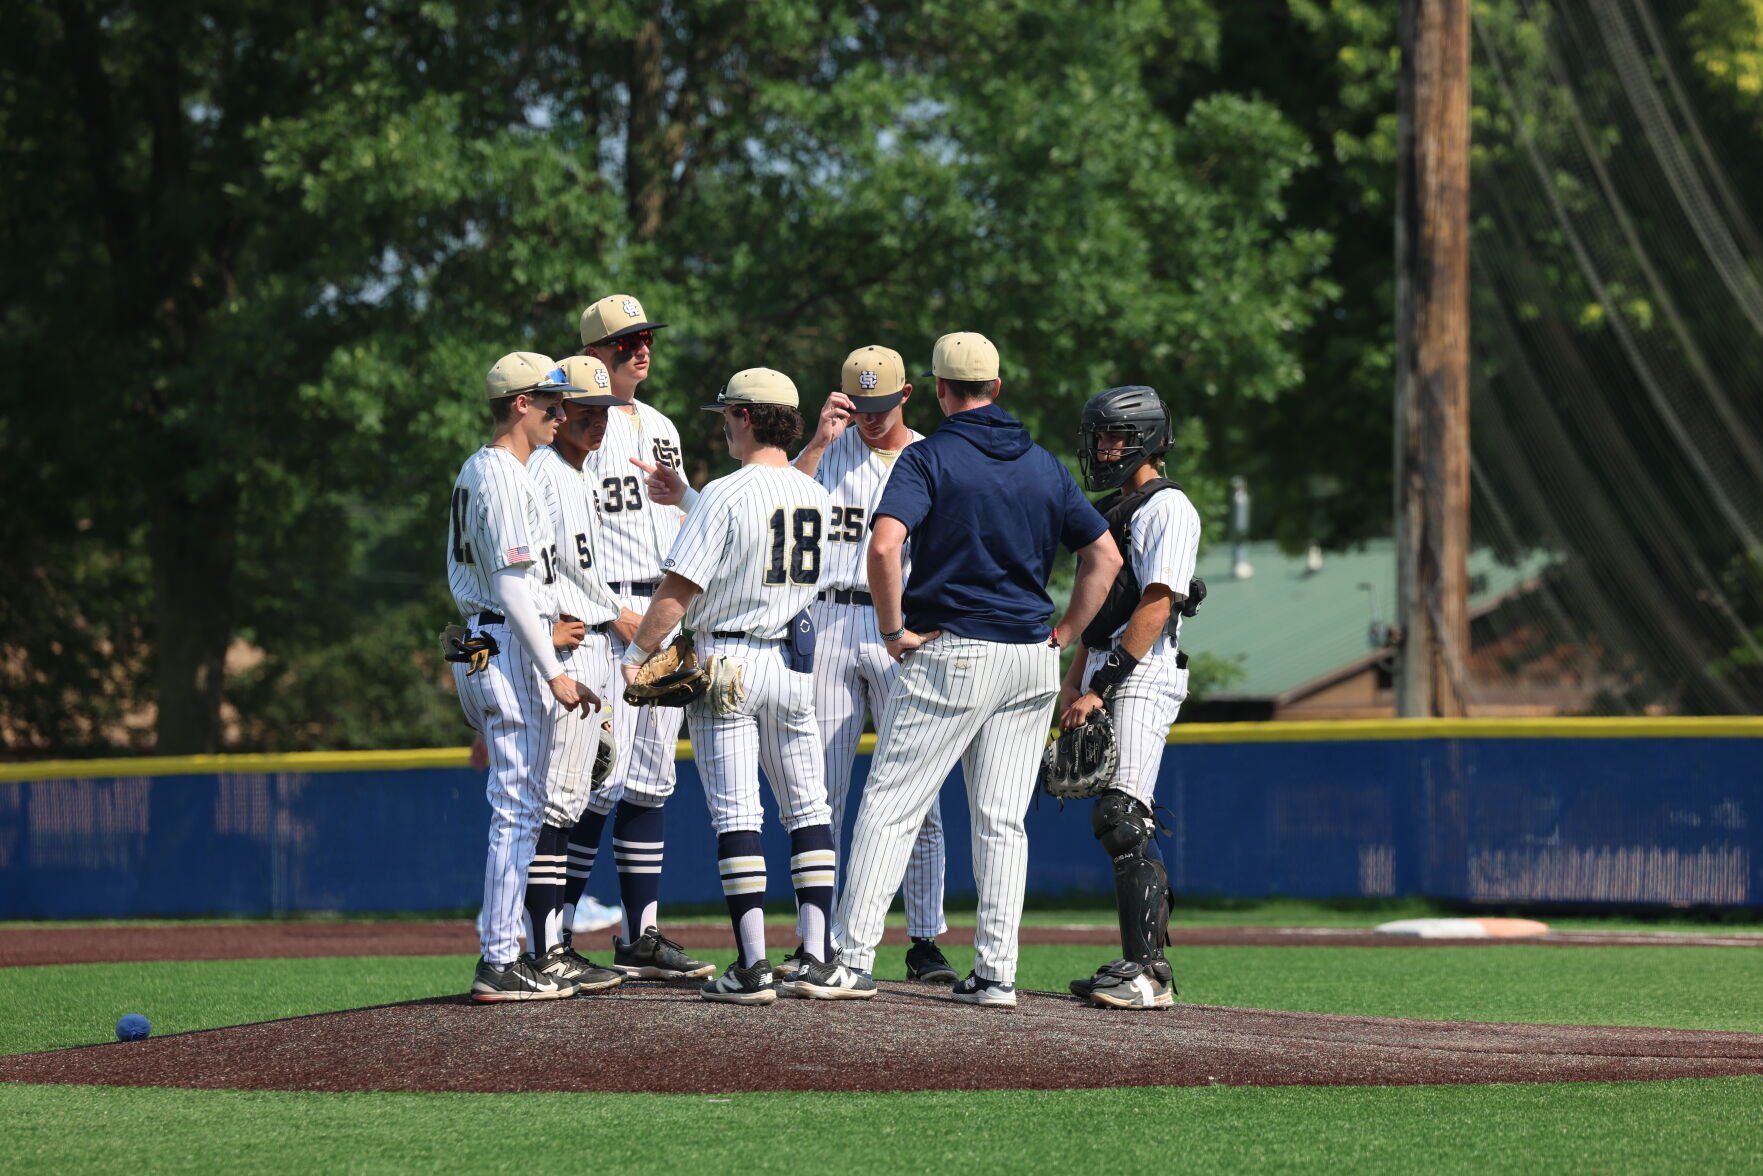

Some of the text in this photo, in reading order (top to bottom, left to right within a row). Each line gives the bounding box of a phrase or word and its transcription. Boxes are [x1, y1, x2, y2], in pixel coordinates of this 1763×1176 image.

[602, 475, 643, 514] 33
[827, 505, 865, 543] 25
[574, 533, 592, 570] 5
[762, 505, 822, 586] 18
